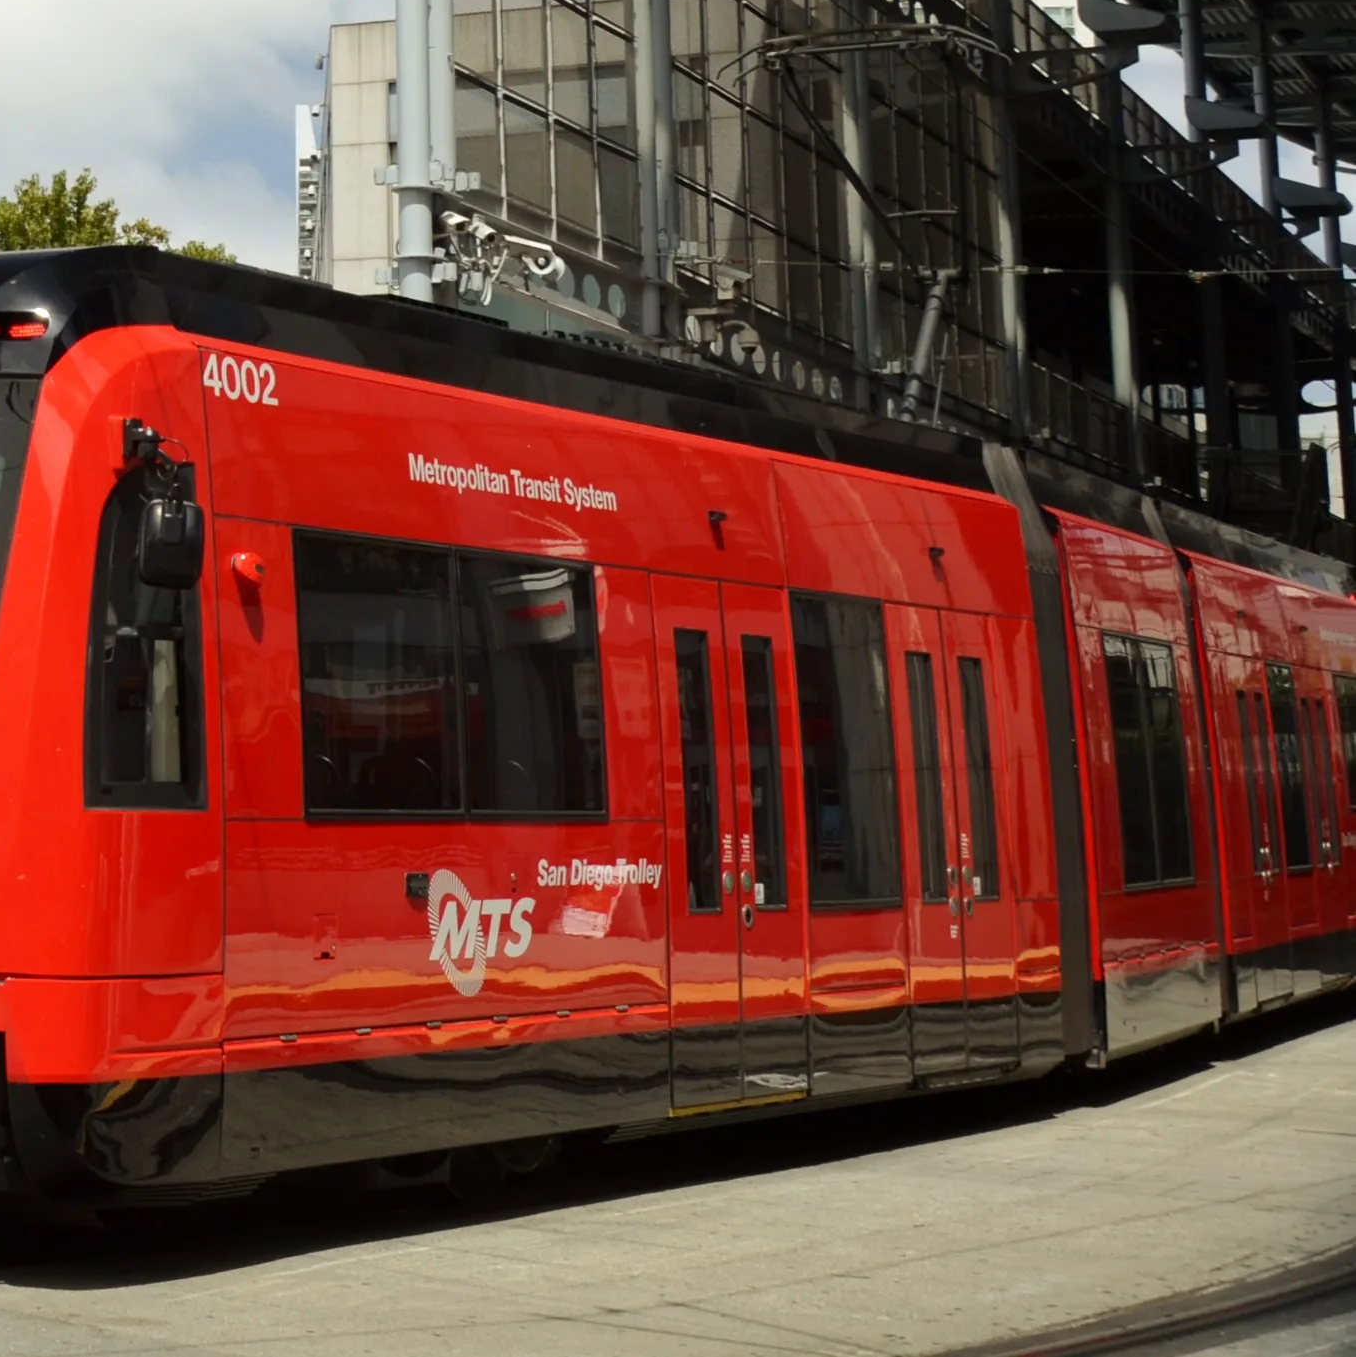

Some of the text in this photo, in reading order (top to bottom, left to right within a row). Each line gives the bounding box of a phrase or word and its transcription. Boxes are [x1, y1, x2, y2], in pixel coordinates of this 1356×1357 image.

[202, 353, 279, 406] 4002
[408, 452, 618, 512] Metropolitan Transit System
[538, 858, 663, 891] San Diego Trolley
[428, 897, 536, 961] MTS
